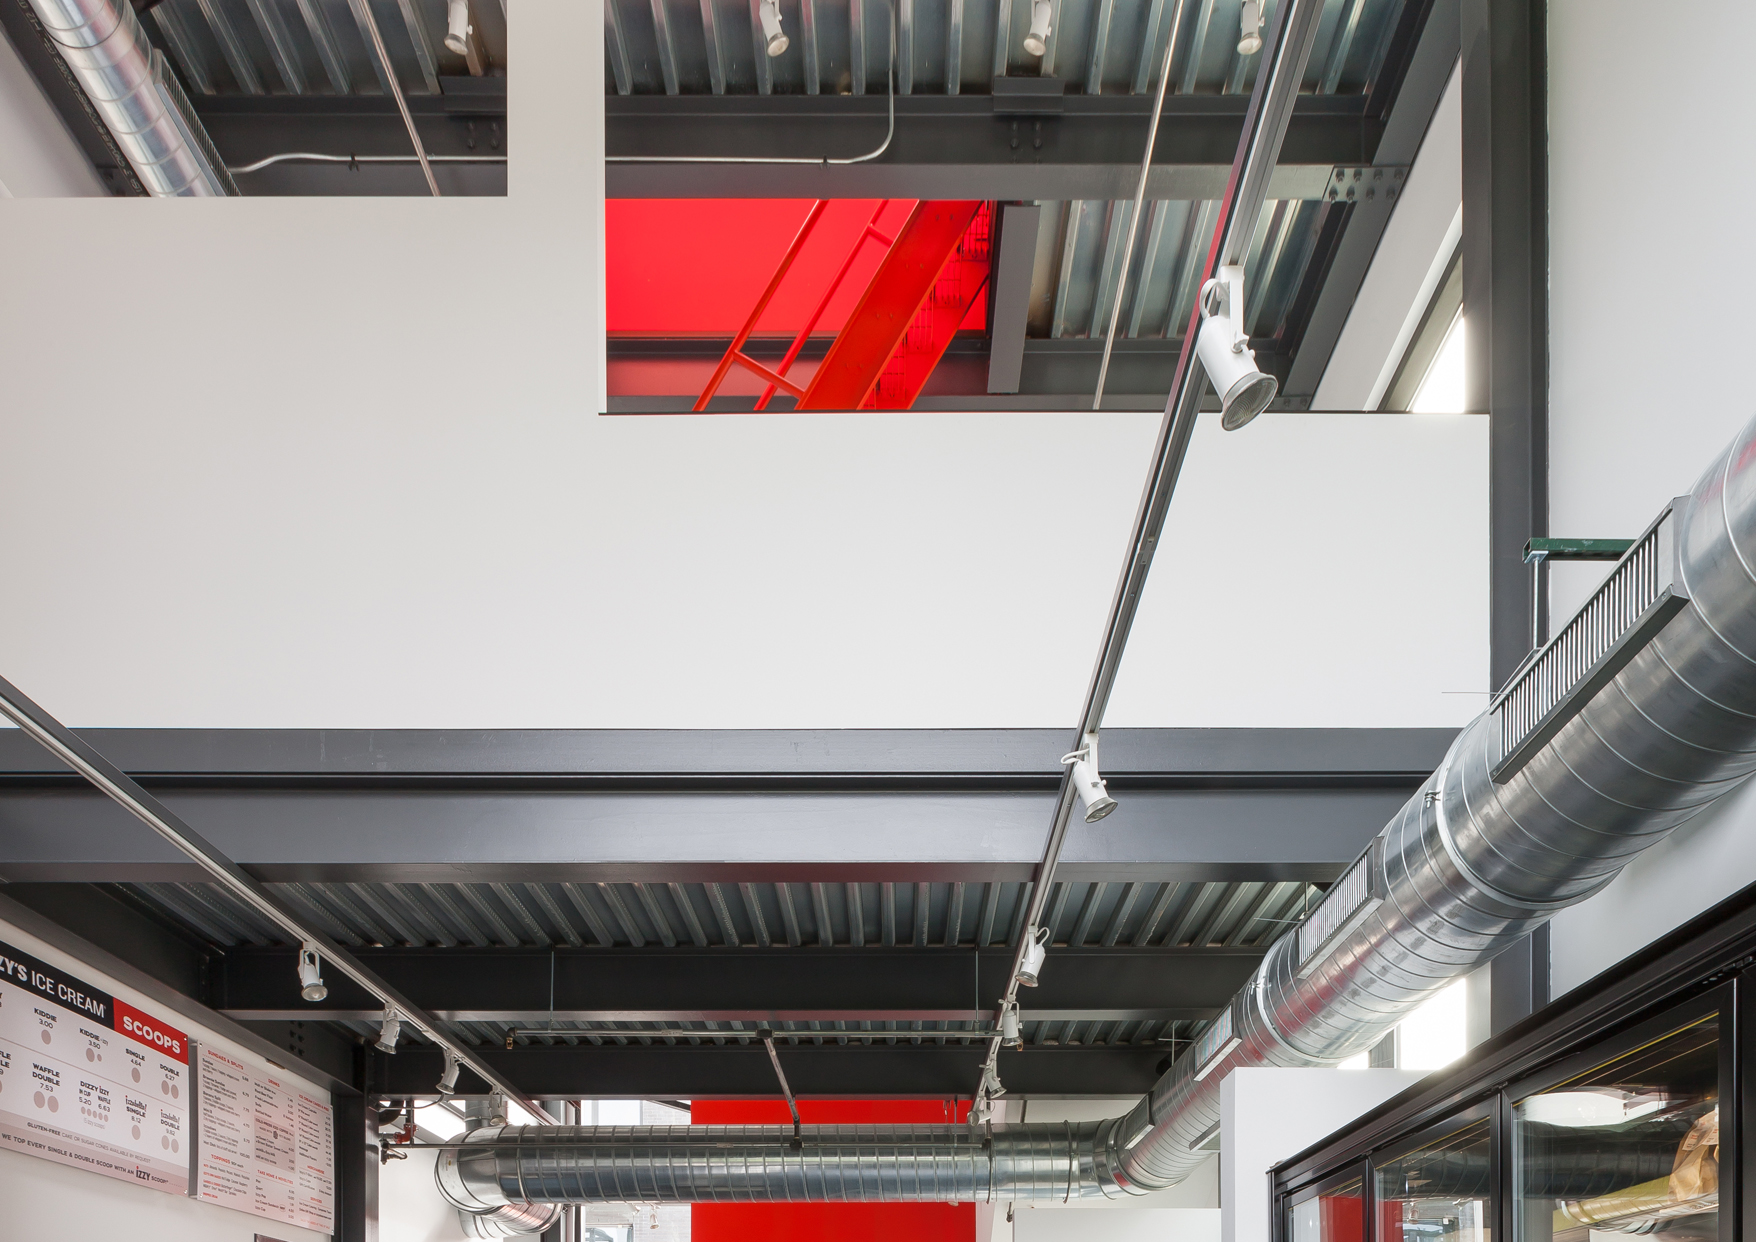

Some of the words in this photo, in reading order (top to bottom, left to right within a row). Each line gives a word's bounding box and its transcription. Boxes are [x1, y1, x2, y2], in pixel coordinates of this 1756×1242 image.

[32, 971, 56, 995] ICE
[59, 984, 104, 1018] CREAM
[34, 1007, 57, 1022] KIDDIE
[39, 1018, 53, 1029] 3.00
[80, 1028, 100, 1041] KIDDIE
[123, 1016, 180, 1053] SCOOPS
[88, 1040, 100, 1049] 3.50
[126, 1049, 145, 1061] SINGLE
[33, 1063, 60, 1077] WAFFLE
[160, 1064, 179, 1076] DOUBLE
[32, 1071, 60, 1086] DOUBLE
[40, 1083, 53, 1092] 7.53
[80, 1081, 98, 1092] DIZZY
[79, 1097, 91, 1105] 5.20
[98, 1104, 110, 1112] 6.63
[126, 1107, 146, 1117] SINGLE
[161, 1120, 179, 1130] DOUBLE
[27, 1122, 60, 1136] GLUTEN-FREE
[110, 1148, 129, 1157] AVAILABLE
[135, 1155, 150, 1163] REQUEST
[13, 1136, 26, 1144] TOP
[27, 1140, 46, 1150] EVERY
[48, 1146, 67, 1156] SINGLE
[74, 1154, 95, 1164] DOUBLE
[96, 1160, 113, 1169] SCOOP
[114, 1165, 126, 1173] WITH
